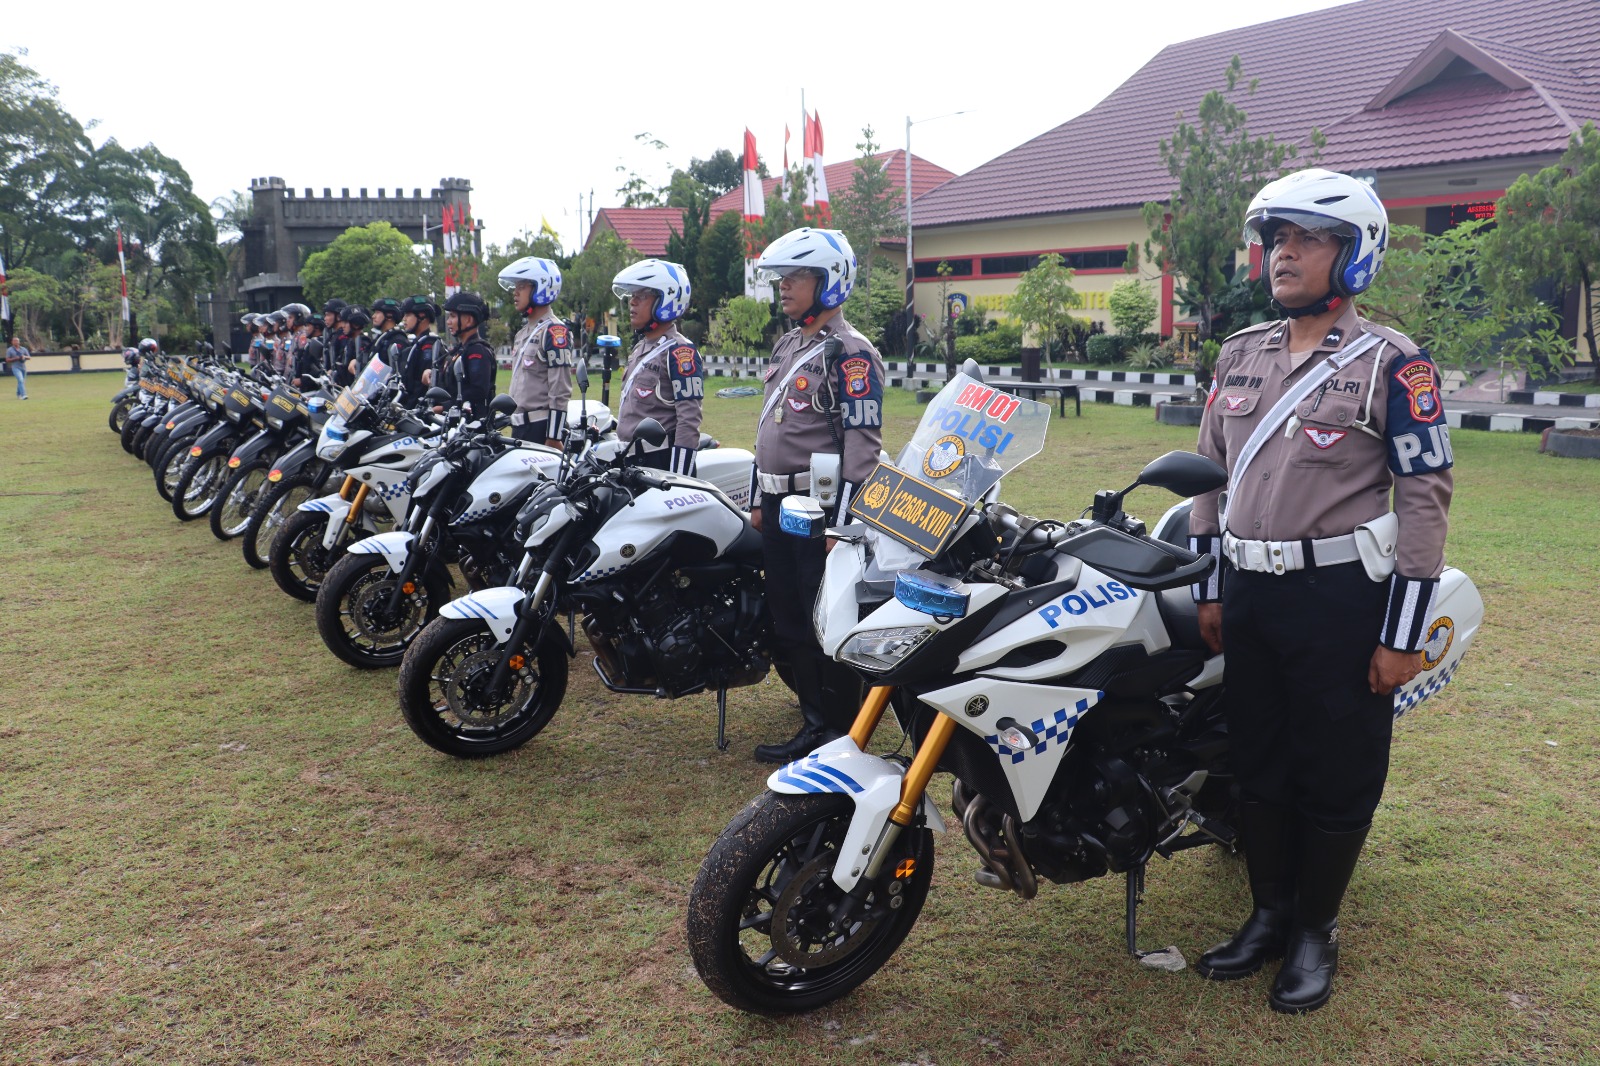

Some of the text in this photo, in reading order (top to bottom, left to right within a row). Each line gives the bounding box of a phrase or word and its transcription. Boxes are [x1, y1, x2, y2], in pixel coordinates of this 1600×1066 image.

[547, 349, 572, 367] PJR
[800, 363, 824, 376] OLRI
[1405, 365, 1428, 377] POLDA
[672, 376, 704, 400] PJR
[1323, 378, 1361, 394] OLRI
[954, 382, 1022, 425] BM 01
[840, 399, 880, 429] PJR
[928, 407, 1015, 455] POLISI
[940, 435, 964, 452] PATROLI
[521, 455, 556, 466] POLISI
[663, 492, 709, 510] POLISI
[889, 489, 954, 538] 122608-XVIII
[1038, 581, 1138, 629] POLISI
